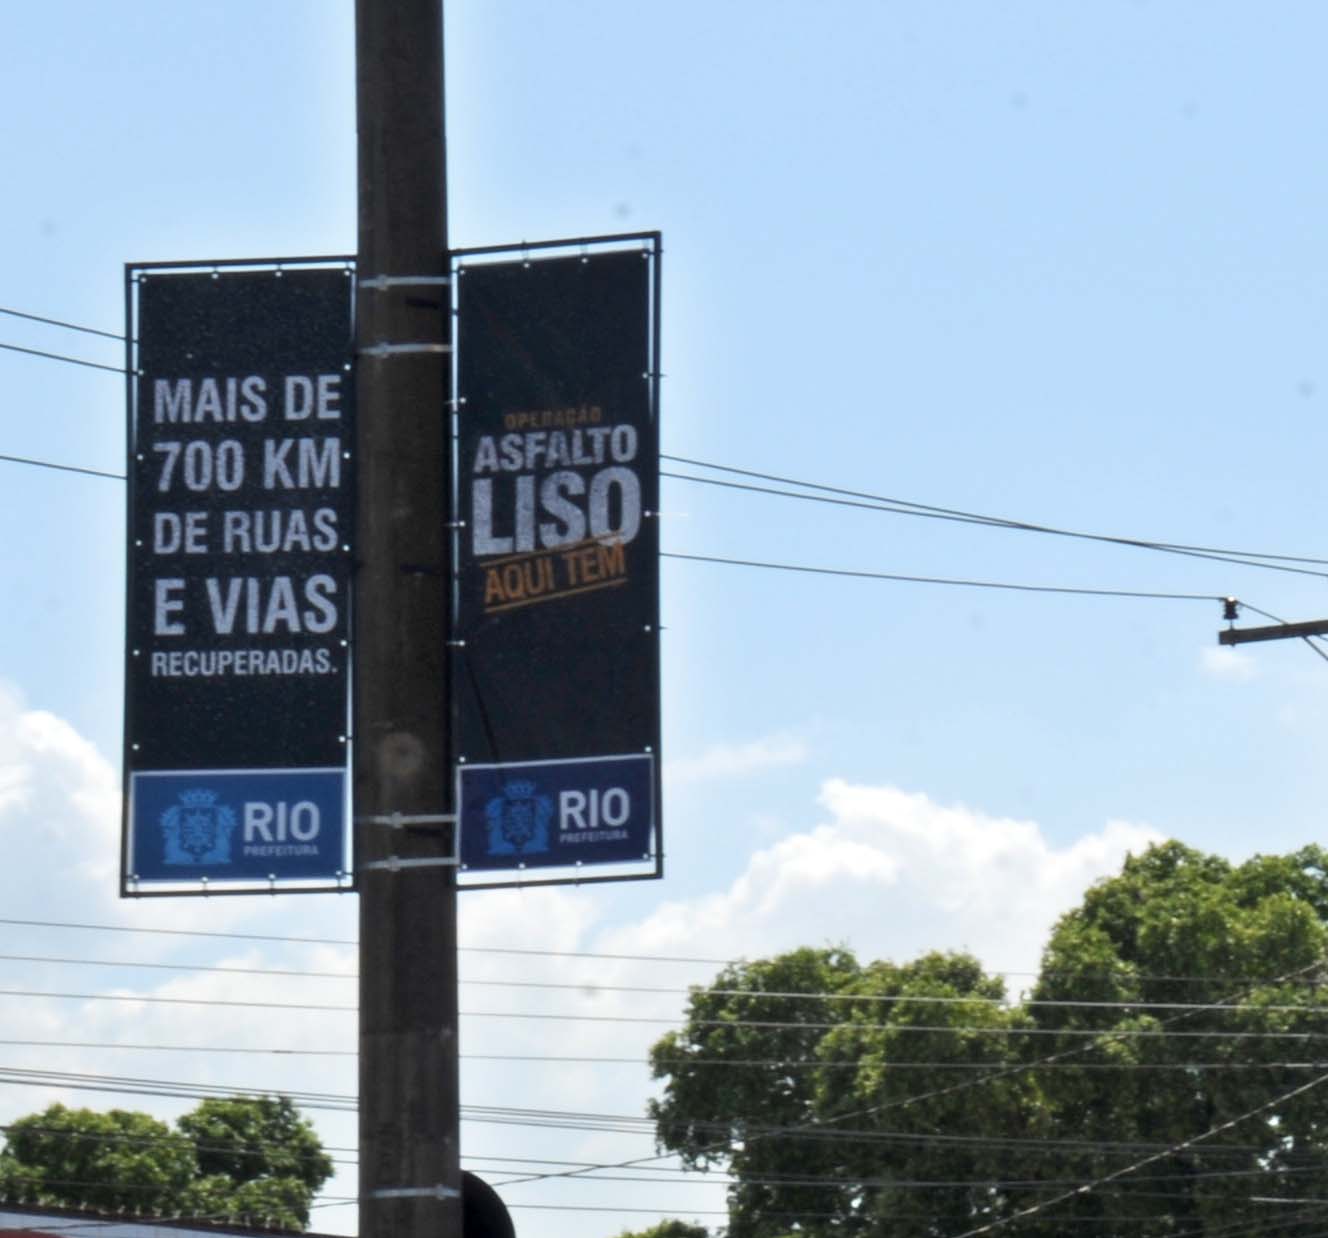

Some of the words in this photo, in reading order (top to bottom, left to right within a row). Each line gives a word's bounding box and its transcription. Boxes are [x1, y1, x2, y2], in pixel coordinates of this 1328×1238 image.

[154, 376, 268, 423] MAIS
[285, 374, 342, 420] DE
[153, 440, 244, 492] 700
[264, 438, 341, 489] KM
[473, 424, 637, 473] ASFALTO
[154, 511, 208, 554] DE
[223, 508, 338, 553] RUAS
[472, 466, 641, 555] LISO
[484, 557, 555, 604] AQUI
[561, 541, 625, 584] TEM
[154, 578, 185, 635] E
[206, 574, 337, 634] VIAS
[151, 648, 338, 677] RECUPERADAS.
[243, 801, 320, 843] RIO
[559, 787, 631, 831] RIO
[243, 845, 319, 857] PREFEITURA
[560, 829, 629, 844] PREFEITURA
